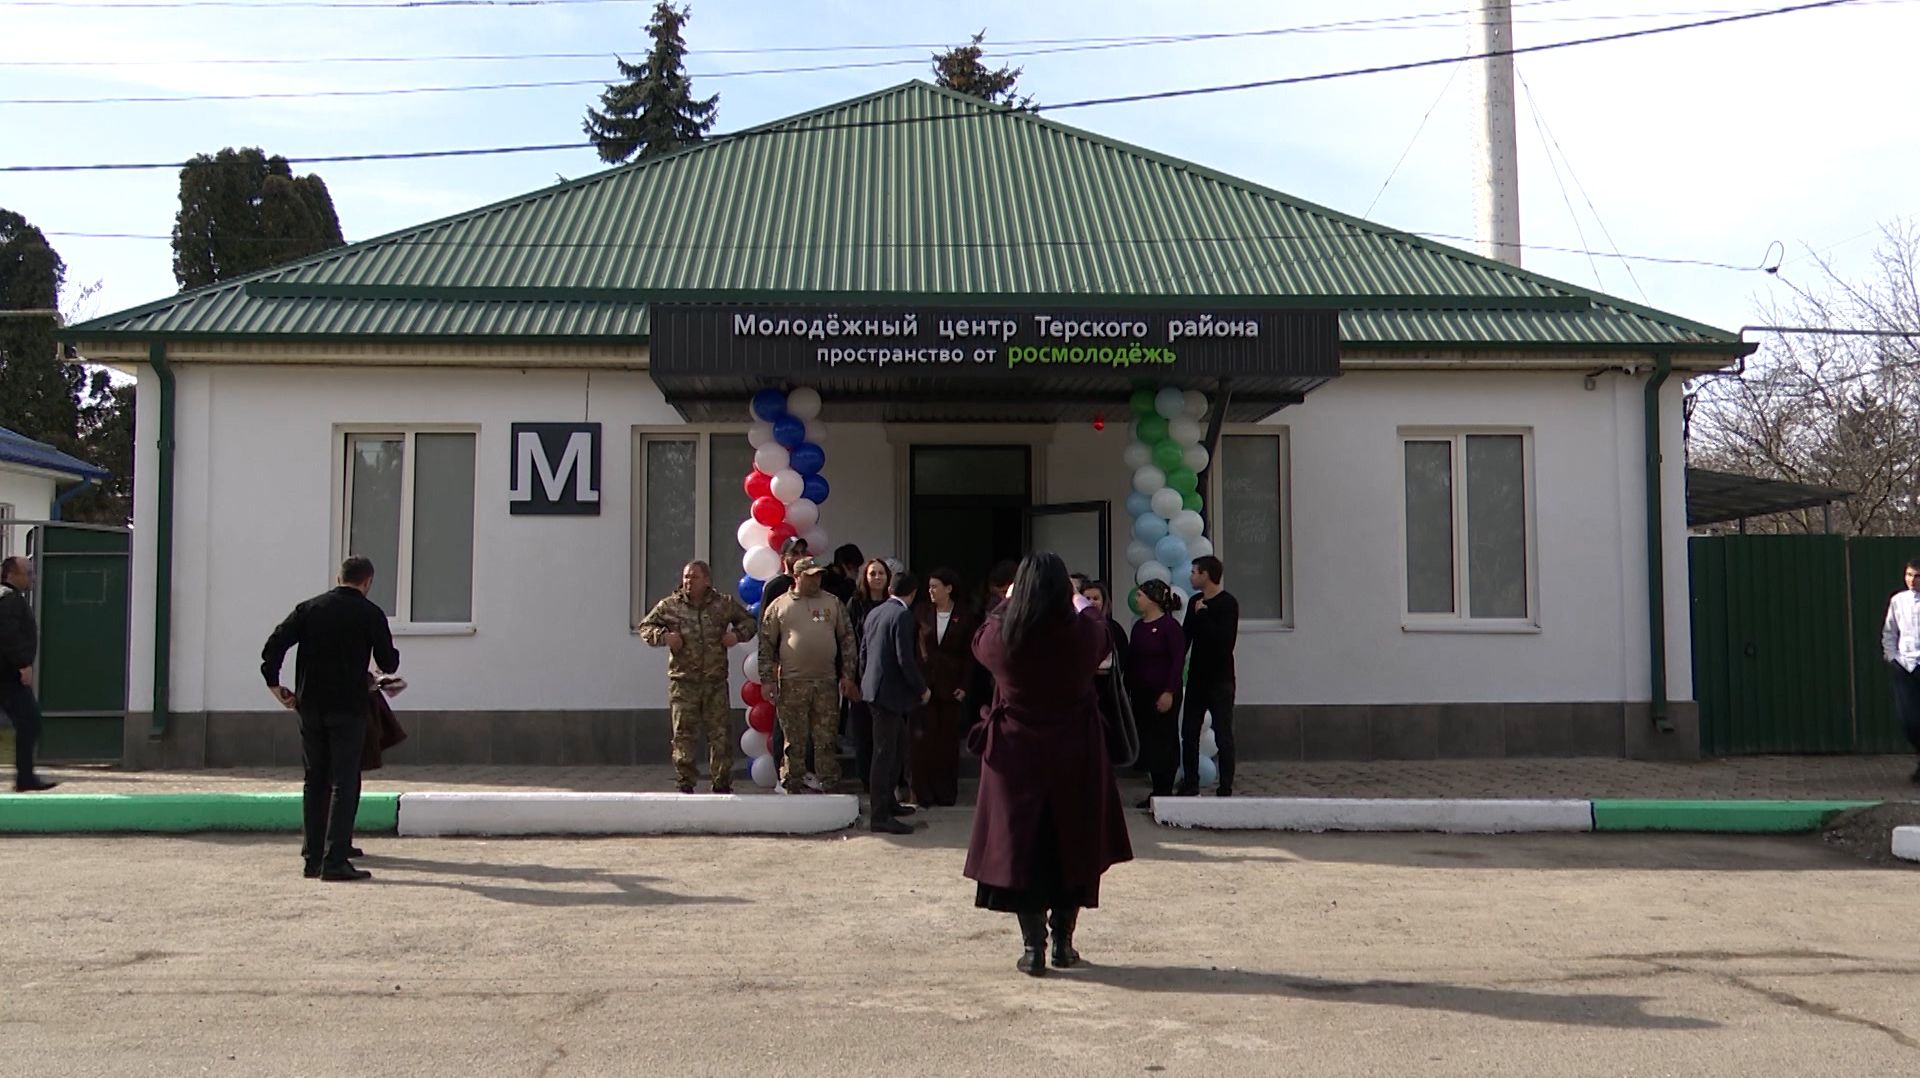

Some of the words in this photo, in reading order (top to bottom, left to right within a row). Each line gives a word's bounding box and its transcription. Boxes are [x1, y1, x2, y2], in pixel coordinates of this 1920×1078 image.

[734, 314, 918, 341] Молодёжный
[939, 319, 1017, 342] центр
[1034, 315, 1148, 342] Терского
[1168, 314, 1260, 342] района
[817, 348, 964, 366] пространство
[973, 349, 997, 363] от
[1008, 343, 1177, 368] росмолодёжь
